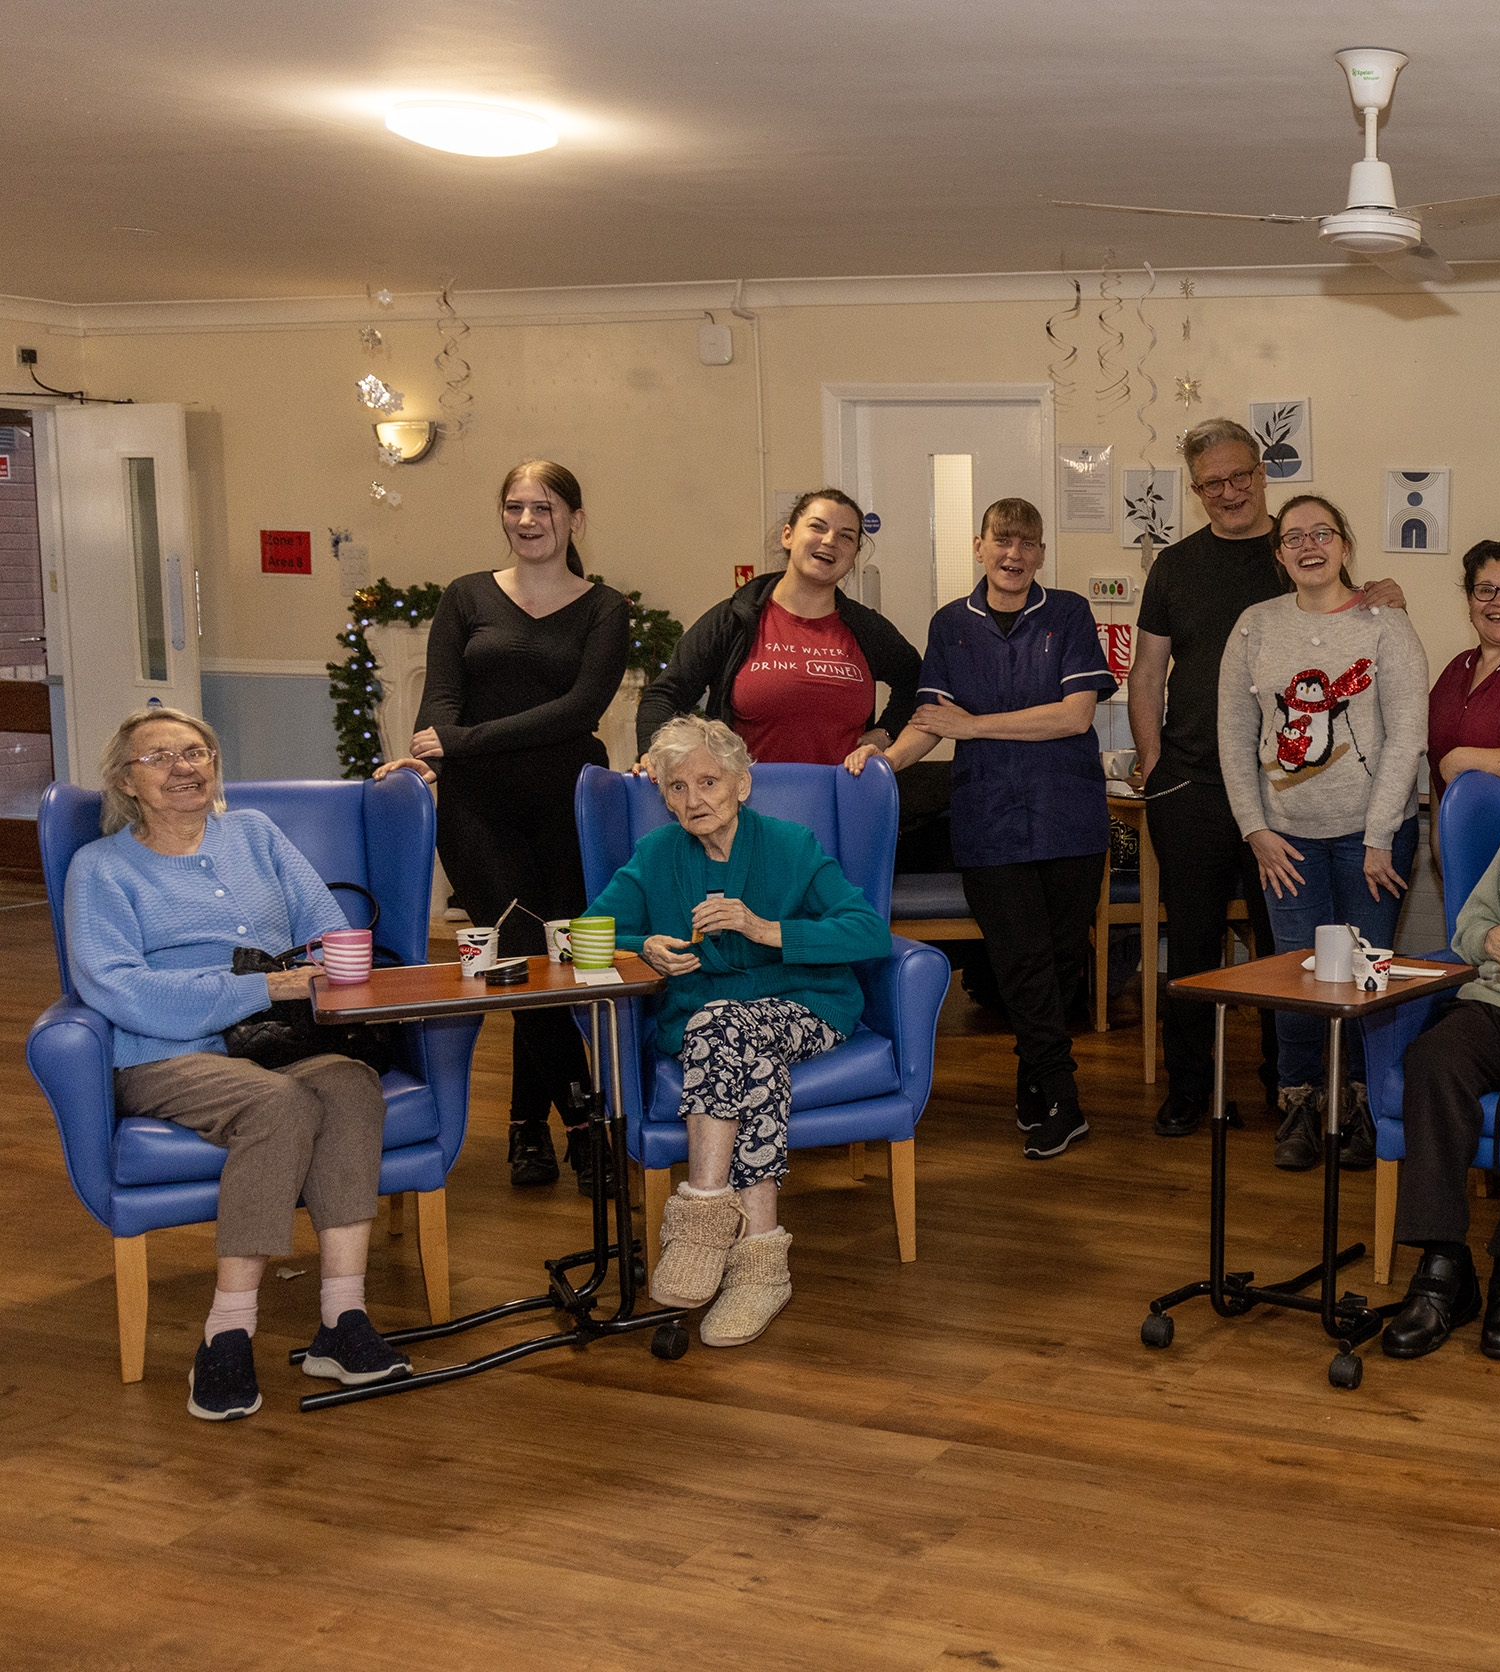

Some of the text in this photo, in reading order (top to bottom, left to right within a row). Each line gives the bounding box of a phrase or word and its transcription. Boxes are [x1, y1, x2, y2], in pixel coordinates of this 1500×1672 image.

[267, 533, 303, 546] Zone 1
[268, 556, 293, 567] Area
[765, 643, 796, 653] SAVE
[751, 660, 857, 678] DRINK WINE!
